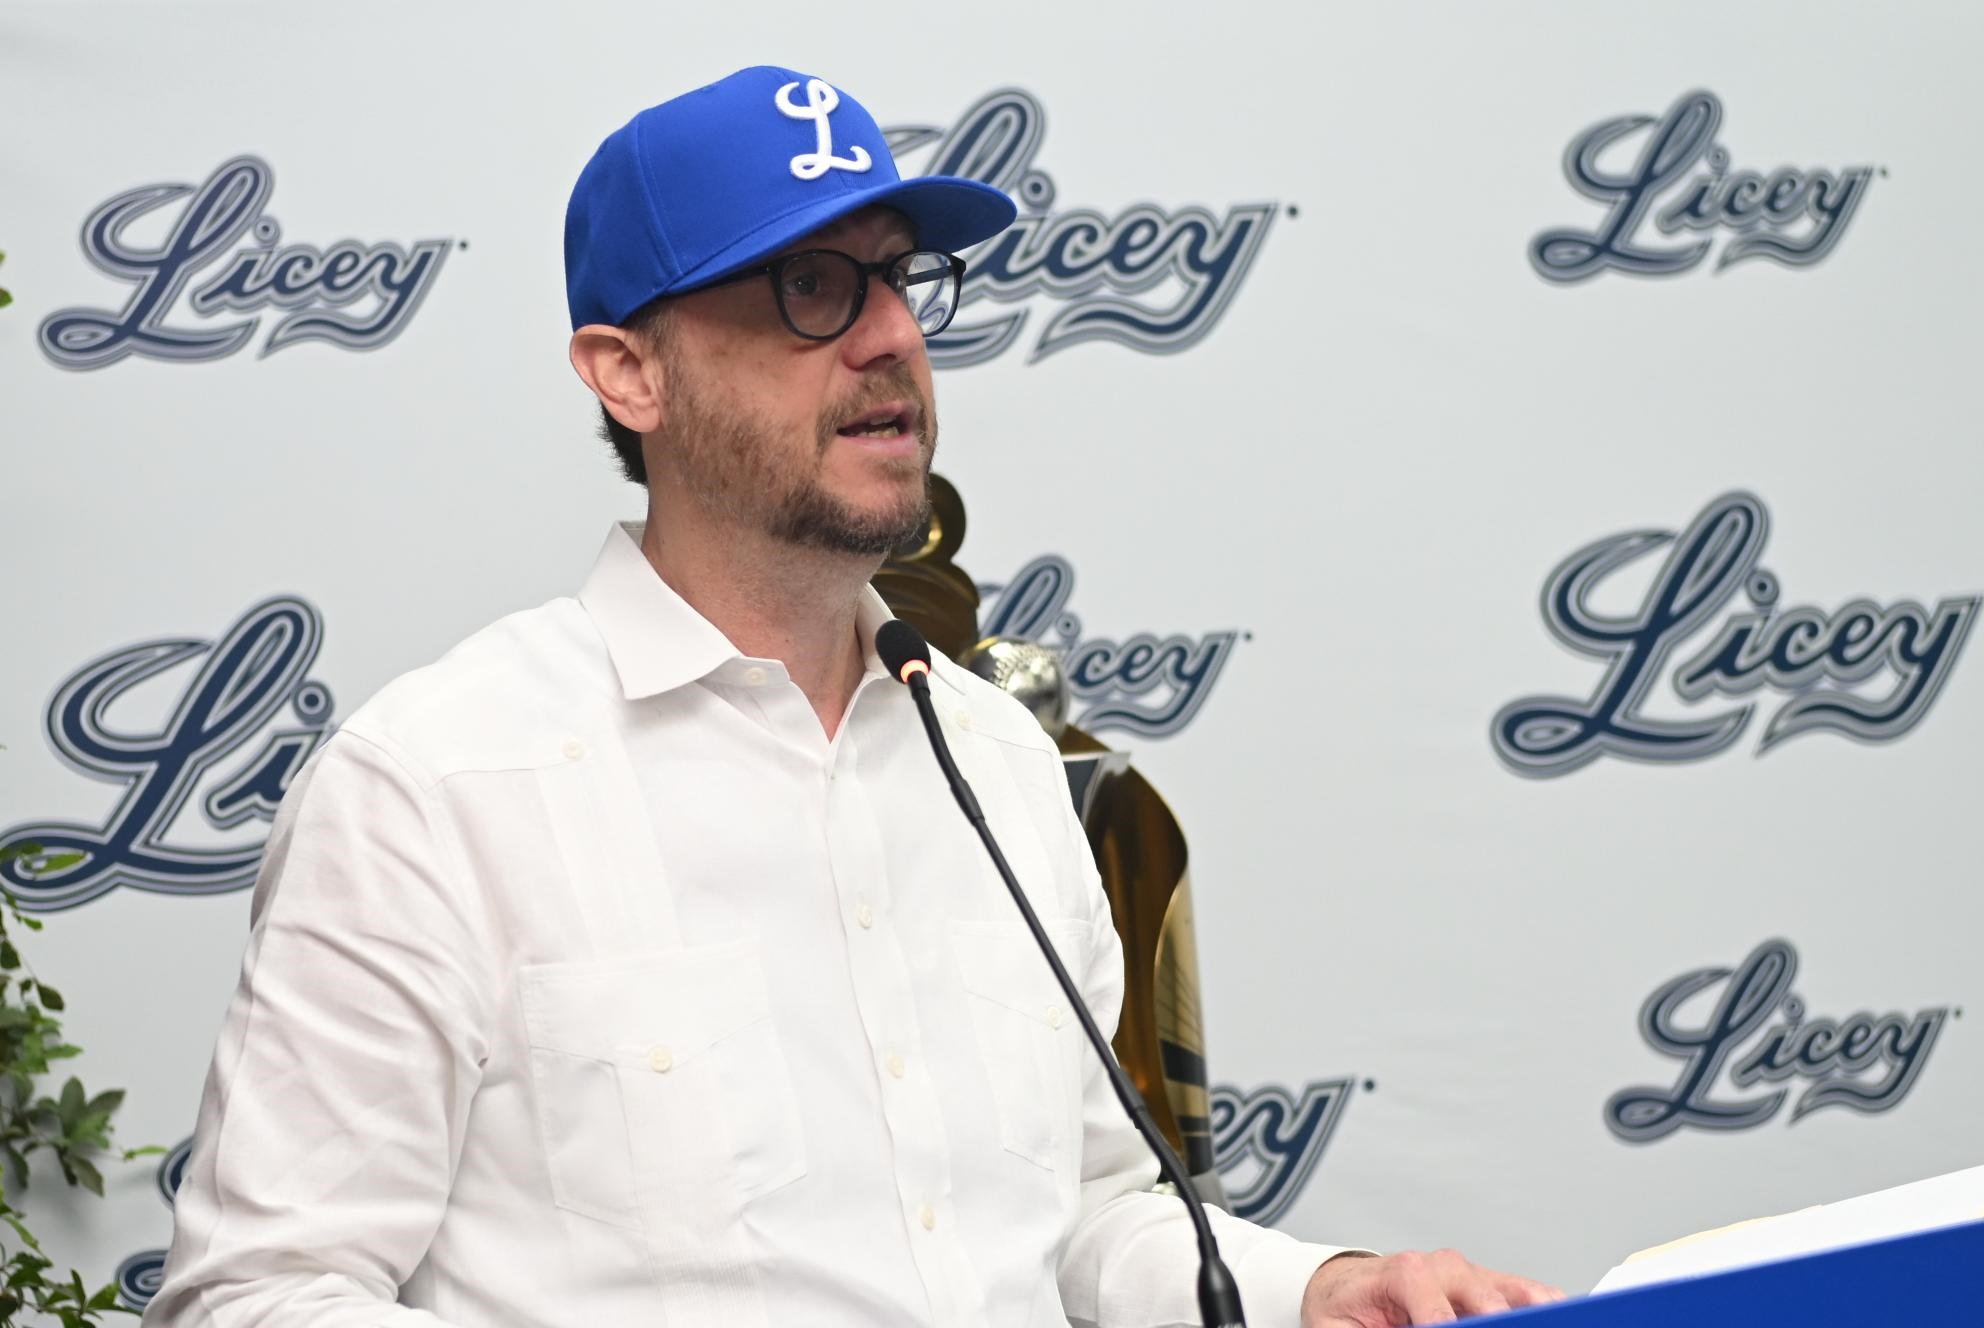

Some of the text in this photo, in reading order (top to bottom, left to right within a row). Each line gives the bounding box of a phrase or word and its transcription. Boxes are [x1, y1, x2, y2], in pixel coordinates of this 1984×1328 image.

[774, 78, 872, 180] L
[1527, 87, 1874, 286] Licey
[36, 154, 454, 372] Licey
[978, 553, 1238, 742] cey
[1489, 489, 1982, 780] Licey
[1603, 937, 1949, 1148] Licey
